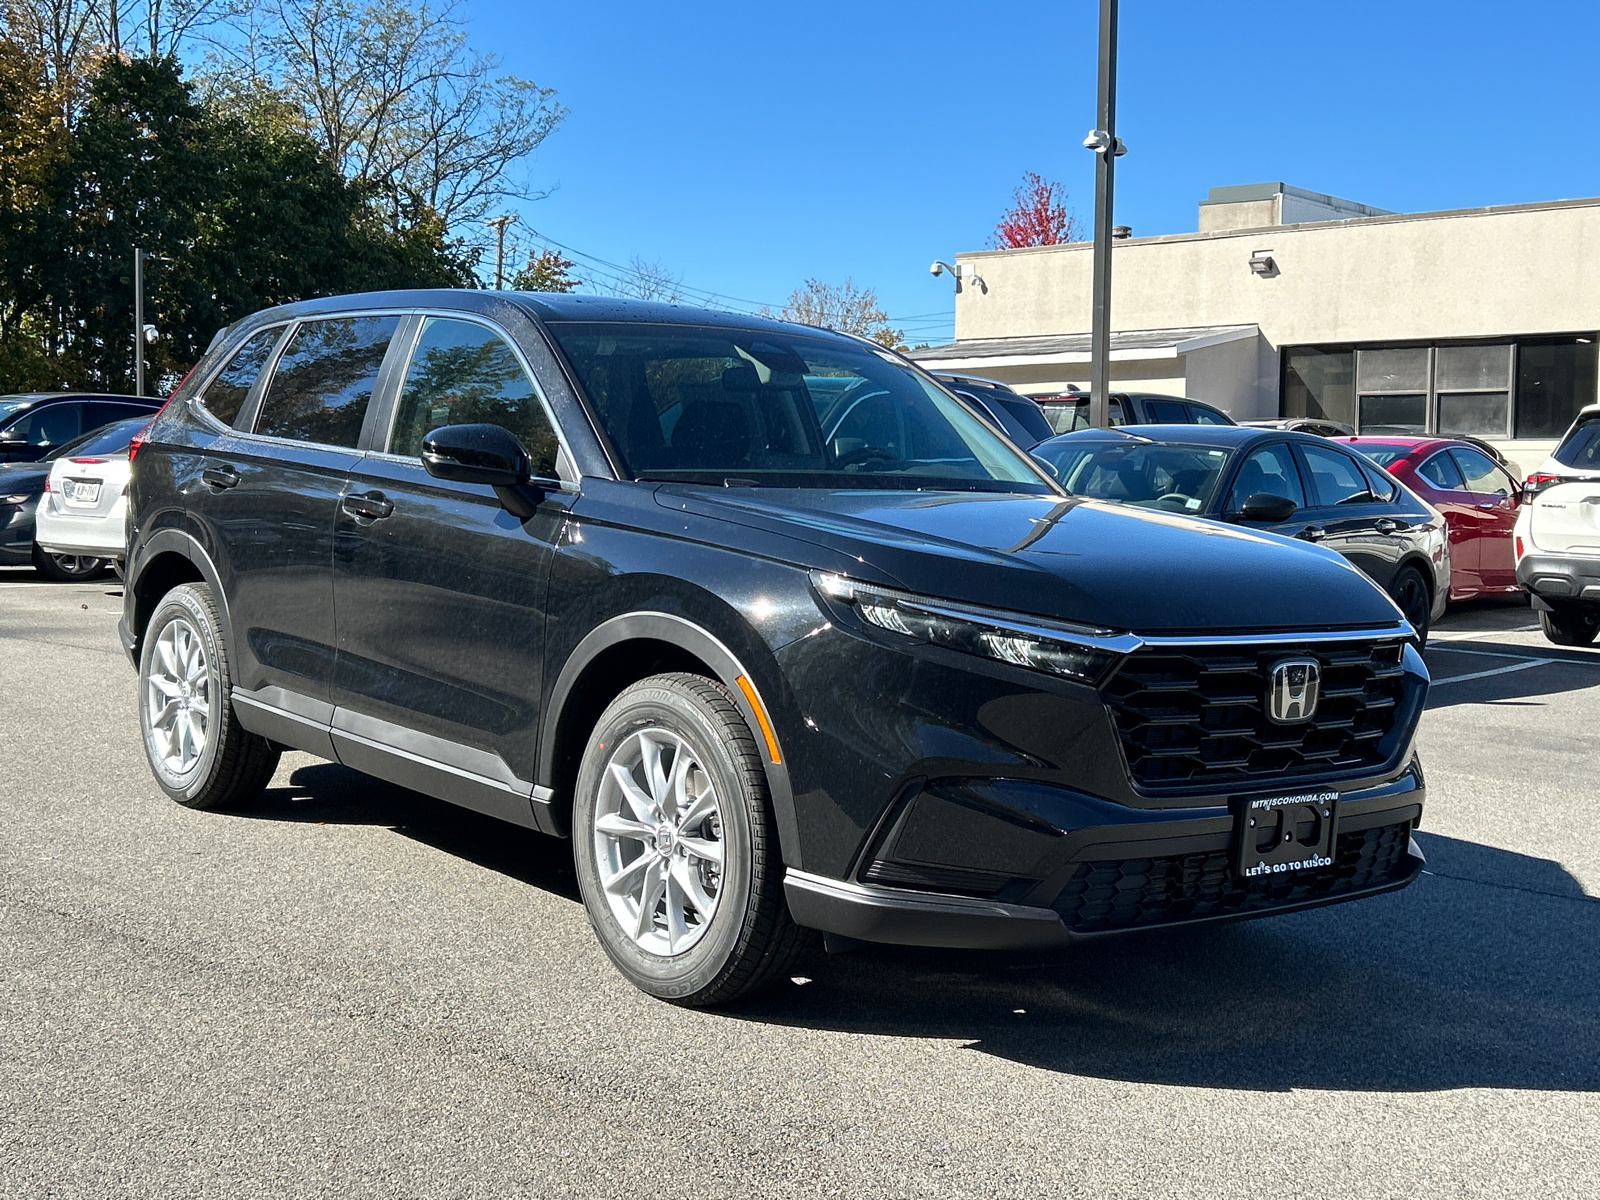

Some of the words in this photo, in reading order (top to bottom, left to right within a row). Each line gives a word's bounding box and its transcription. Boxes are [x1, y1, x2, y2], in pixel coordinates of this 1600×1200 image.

[1252, 793, 1339, 809] MTKISCOHONDA.COM
[1273, 863, 1287, 873] GO
[1289, 861, 1301, 871] TO
[1303, 857, 1332, 869] KISCO
